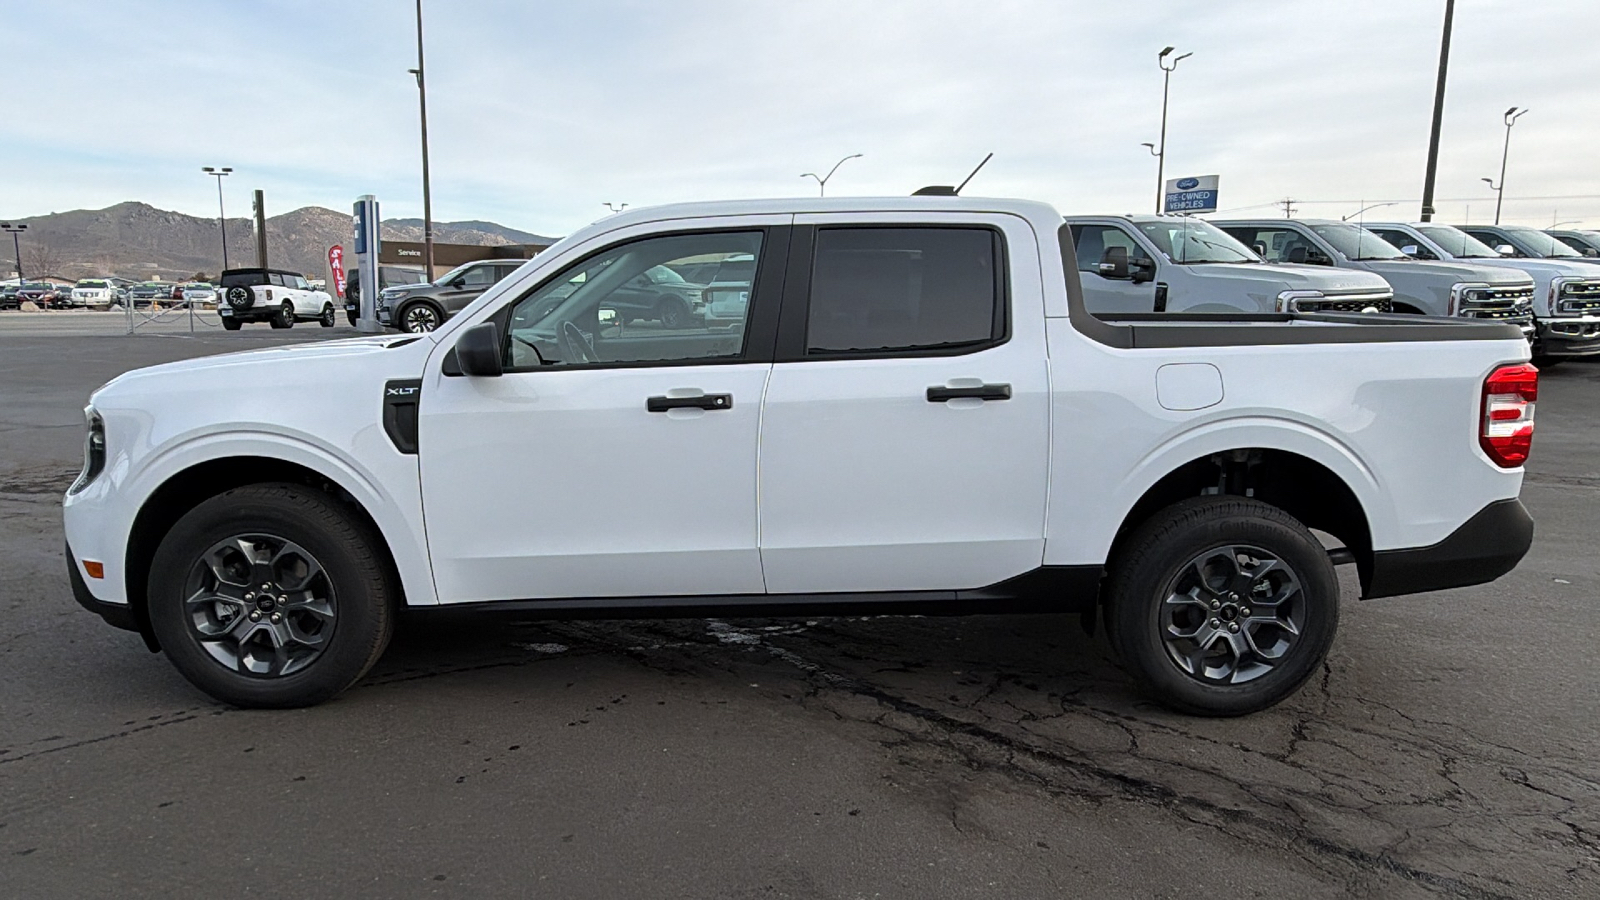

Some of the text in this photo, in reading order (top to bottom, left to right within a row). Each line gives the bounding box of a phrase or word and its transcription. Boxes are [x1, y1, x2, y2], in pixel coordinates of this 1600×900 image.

[1166, 191, 1210, 202] PRE-OWNED
[1169, 200, 1204, 210] VEHICLES
[397, 248, 421, 257] Service
[329, 249, 346, 293] SALE
[386, 387, 419, 396] XLT
